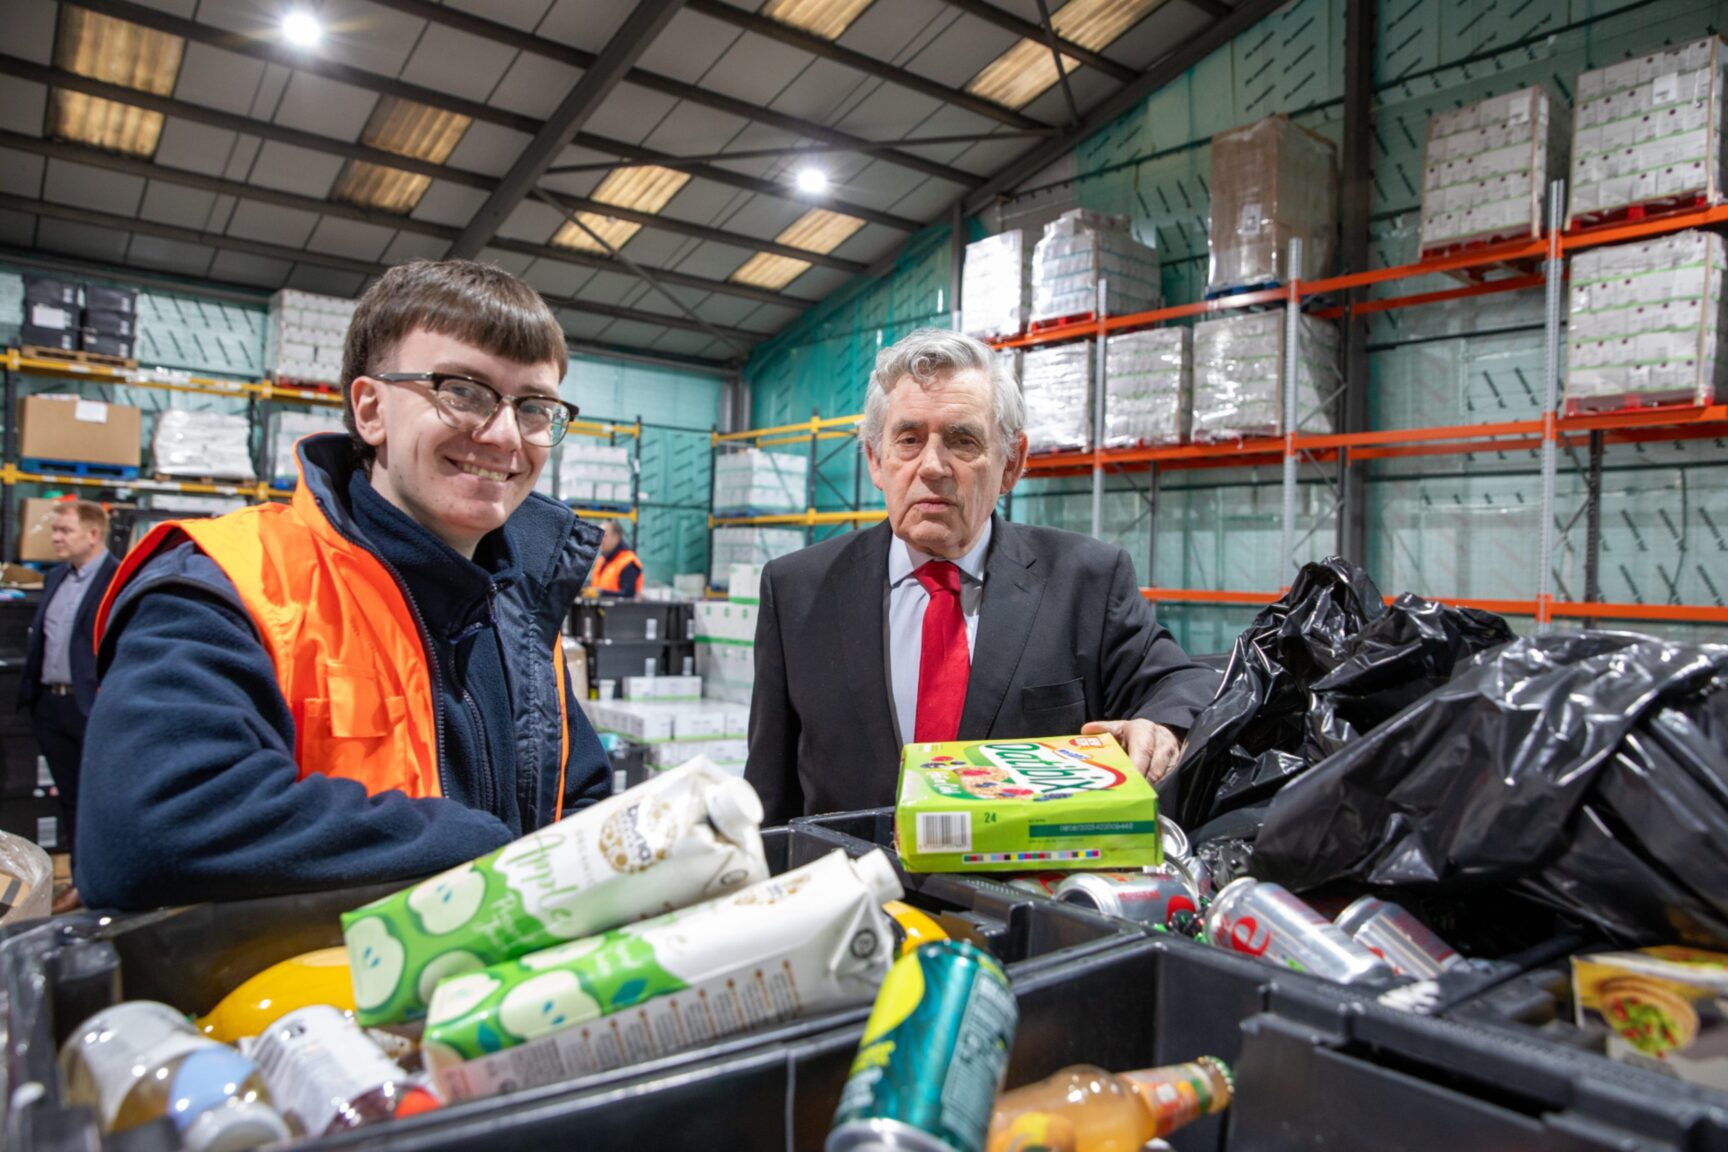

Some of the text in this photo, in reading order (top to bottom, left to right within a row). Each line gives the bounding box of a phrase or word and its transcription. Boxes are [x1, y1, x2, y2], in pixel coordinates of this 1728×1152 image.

[983, 743, 1106, 793] Oatibix
[984, 812, 997, 824] 24
[505, 832, 578, 922] Apple
